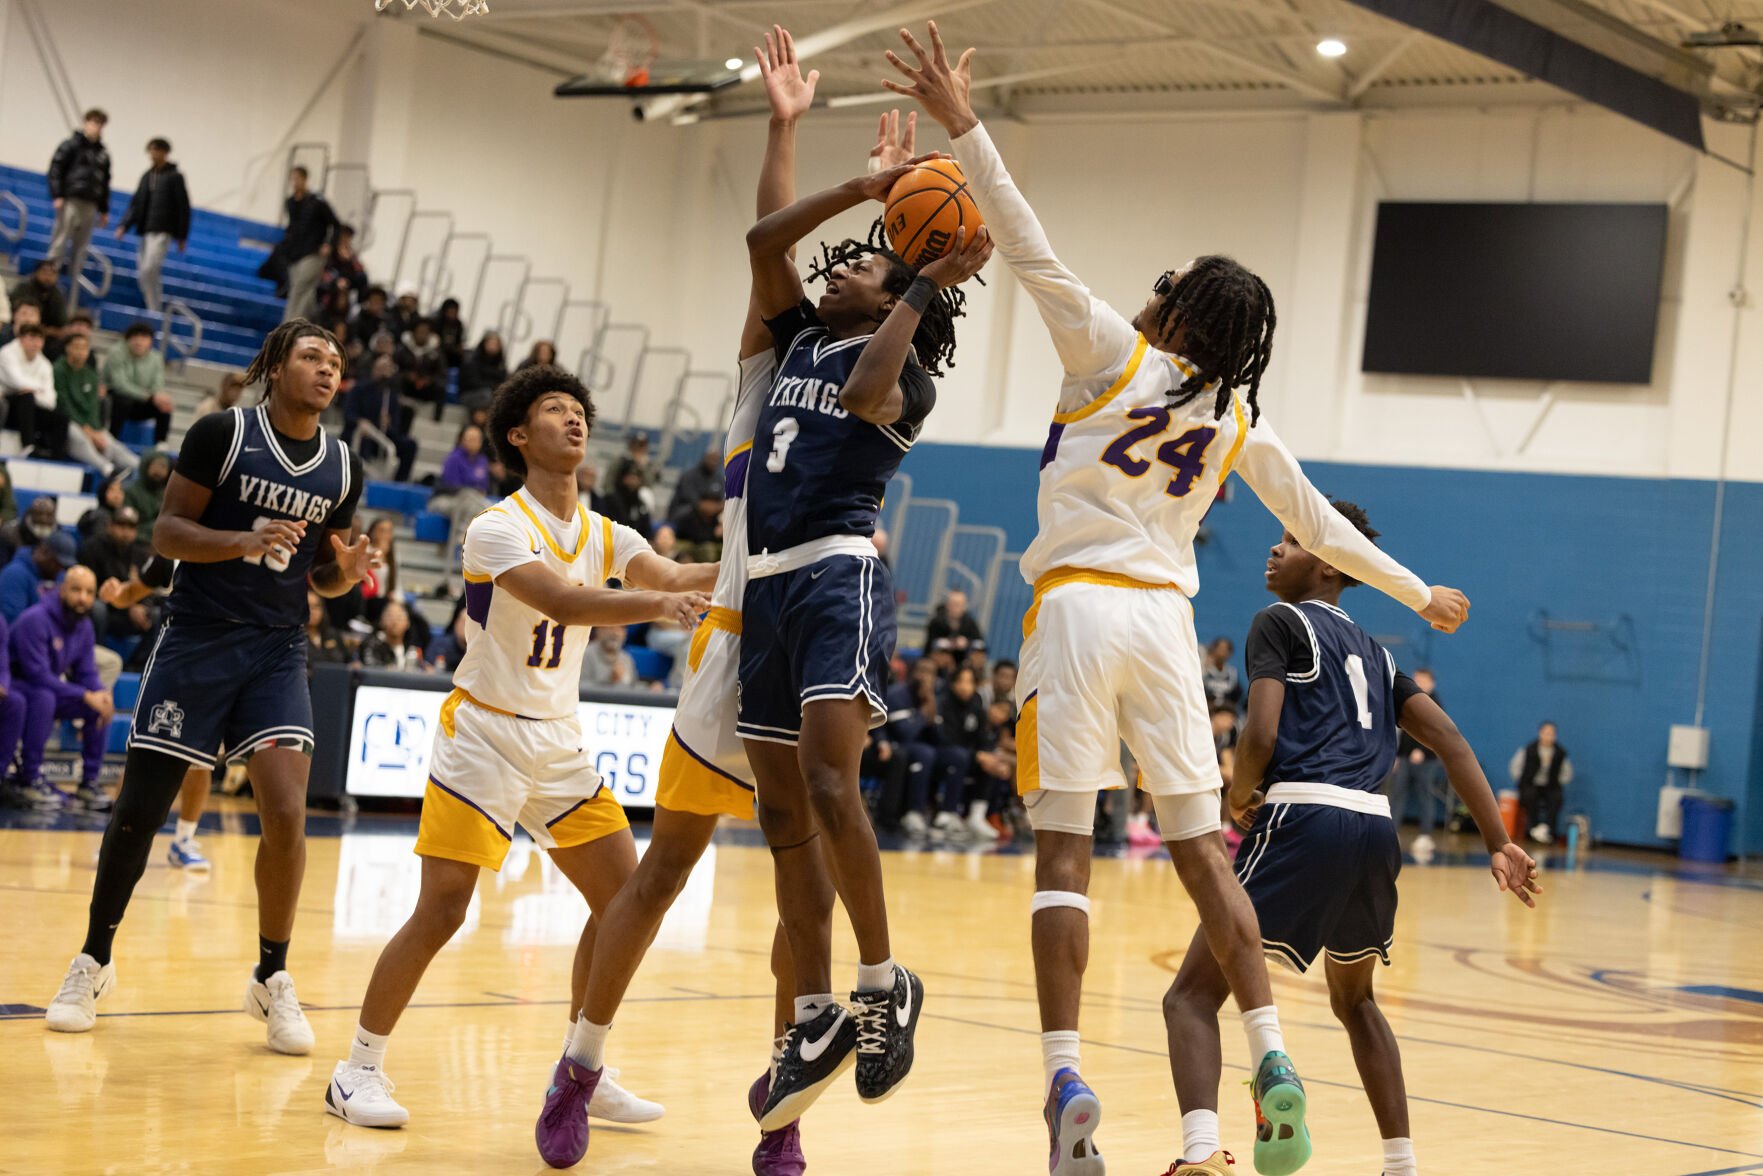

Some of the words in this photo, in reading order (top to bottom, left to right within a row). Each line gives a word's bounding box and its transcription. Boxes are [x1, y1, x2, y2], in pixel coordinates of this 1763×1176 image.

[766, 417, 800, 473] 3
[1099, 406, 1217, 498] 24
[239, 474, 332, 524] VIKINGS
[526, 619, 567, 669] 11
[1344, 653, 1373, 730] 1
[596, 711, 653, 738] CITY
